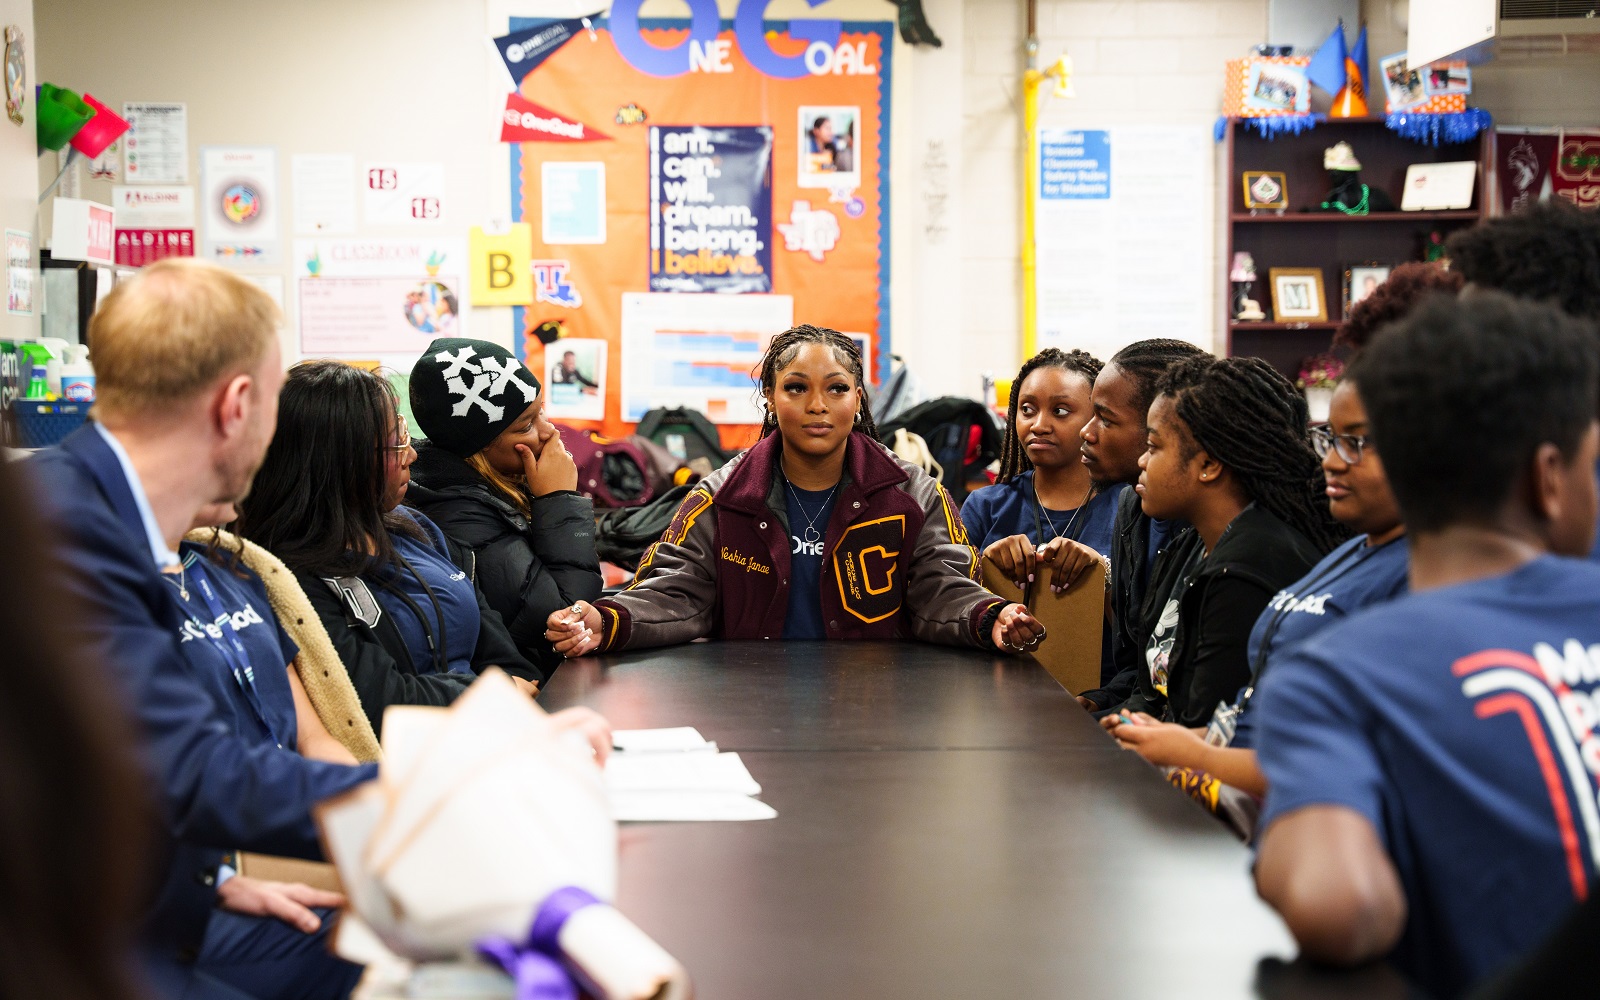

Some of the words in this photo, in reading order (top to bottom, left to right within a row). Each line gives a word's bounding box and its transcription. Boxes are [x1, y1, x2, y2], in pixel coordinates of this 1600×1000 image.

[663, 132, 714, 154] am.
[663, 156, 721, 178] can.
[663, 176, 714, 202] will.
[663, 199, 758, 226] dream.
[117, 231, 191, 247] ALDINE
[664, 224, 764, 256] belong.
[489, 253, 514, 289] B
[664, 247, 764, 275] believe.
